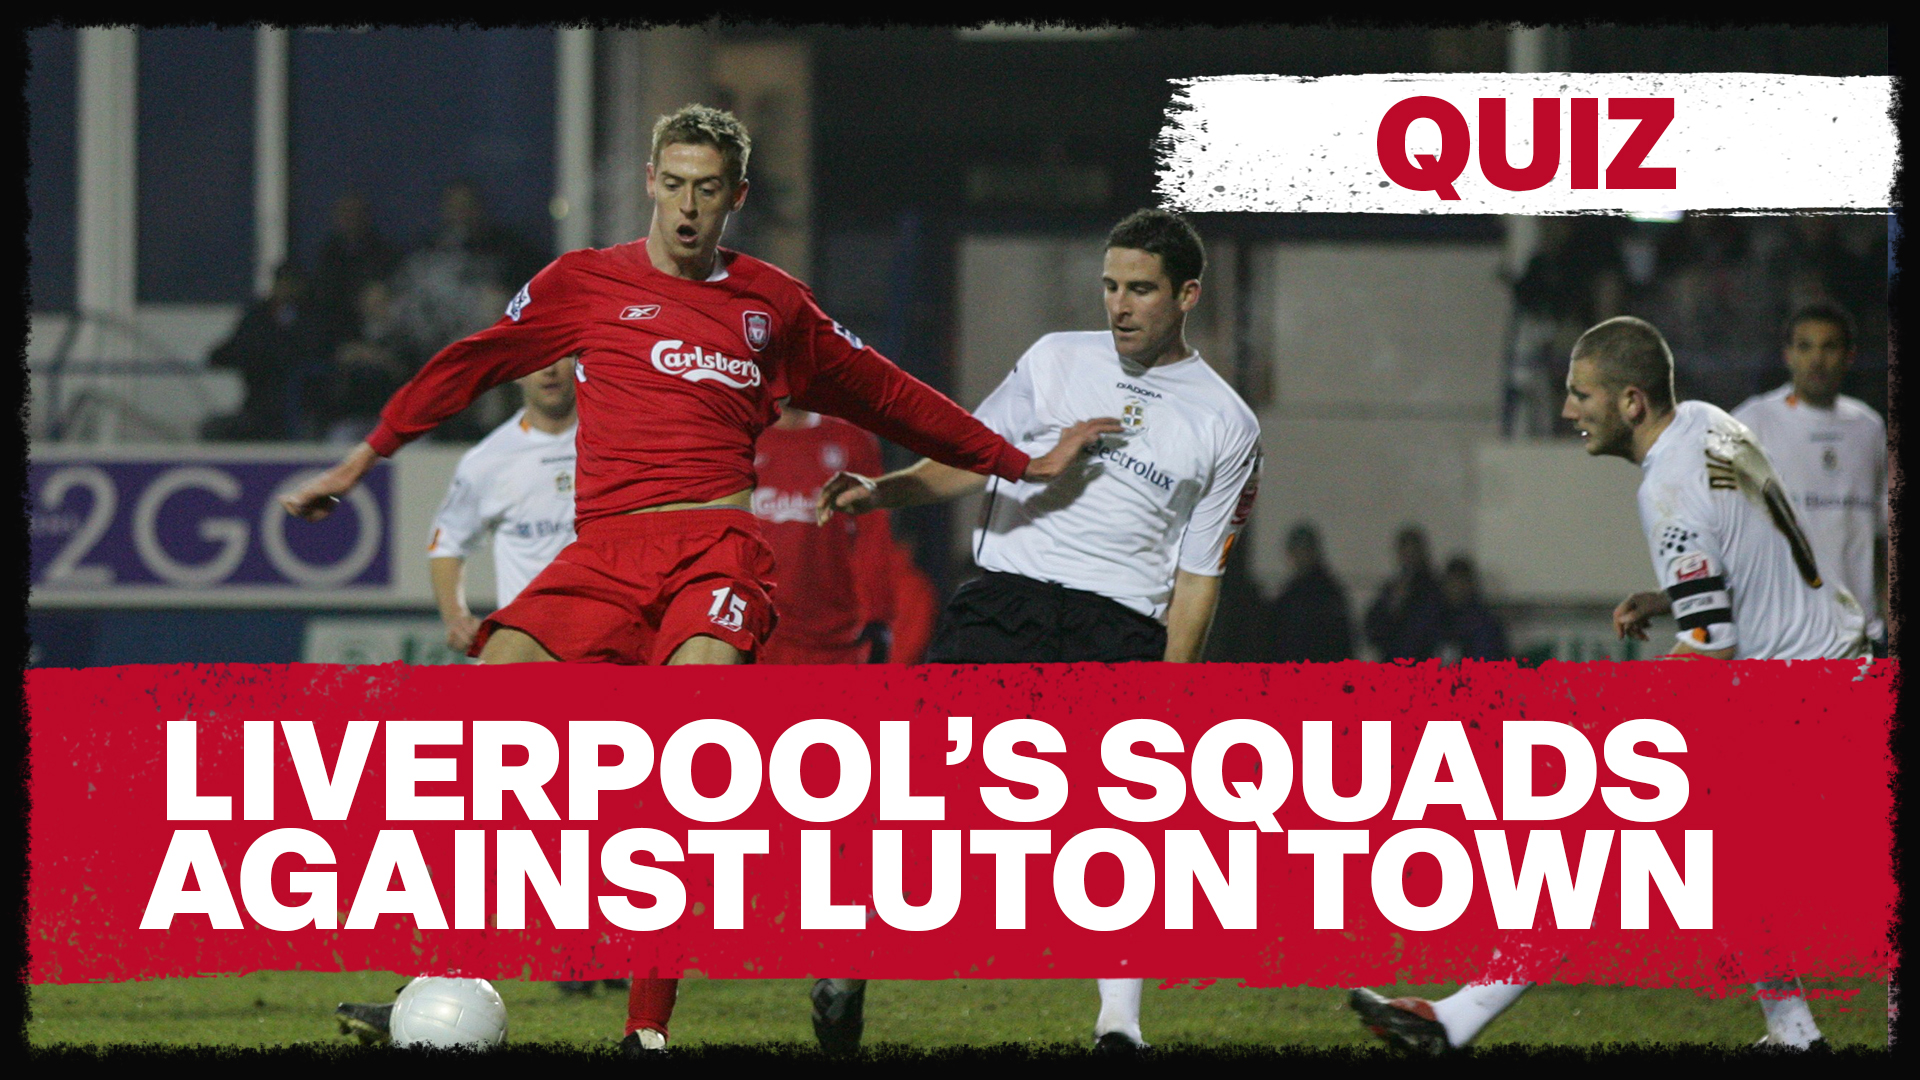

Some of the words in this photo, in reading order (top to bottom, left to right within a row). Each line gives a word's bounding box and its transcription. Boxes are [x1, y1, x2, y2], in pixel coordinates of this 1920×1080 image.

[651, 340, 761, 387] Carlsberg
[1116, 382, 1163, 399] DIADORA
[43, 466, 383, 586] 2GO
[707, 586, 748, 627] 15
